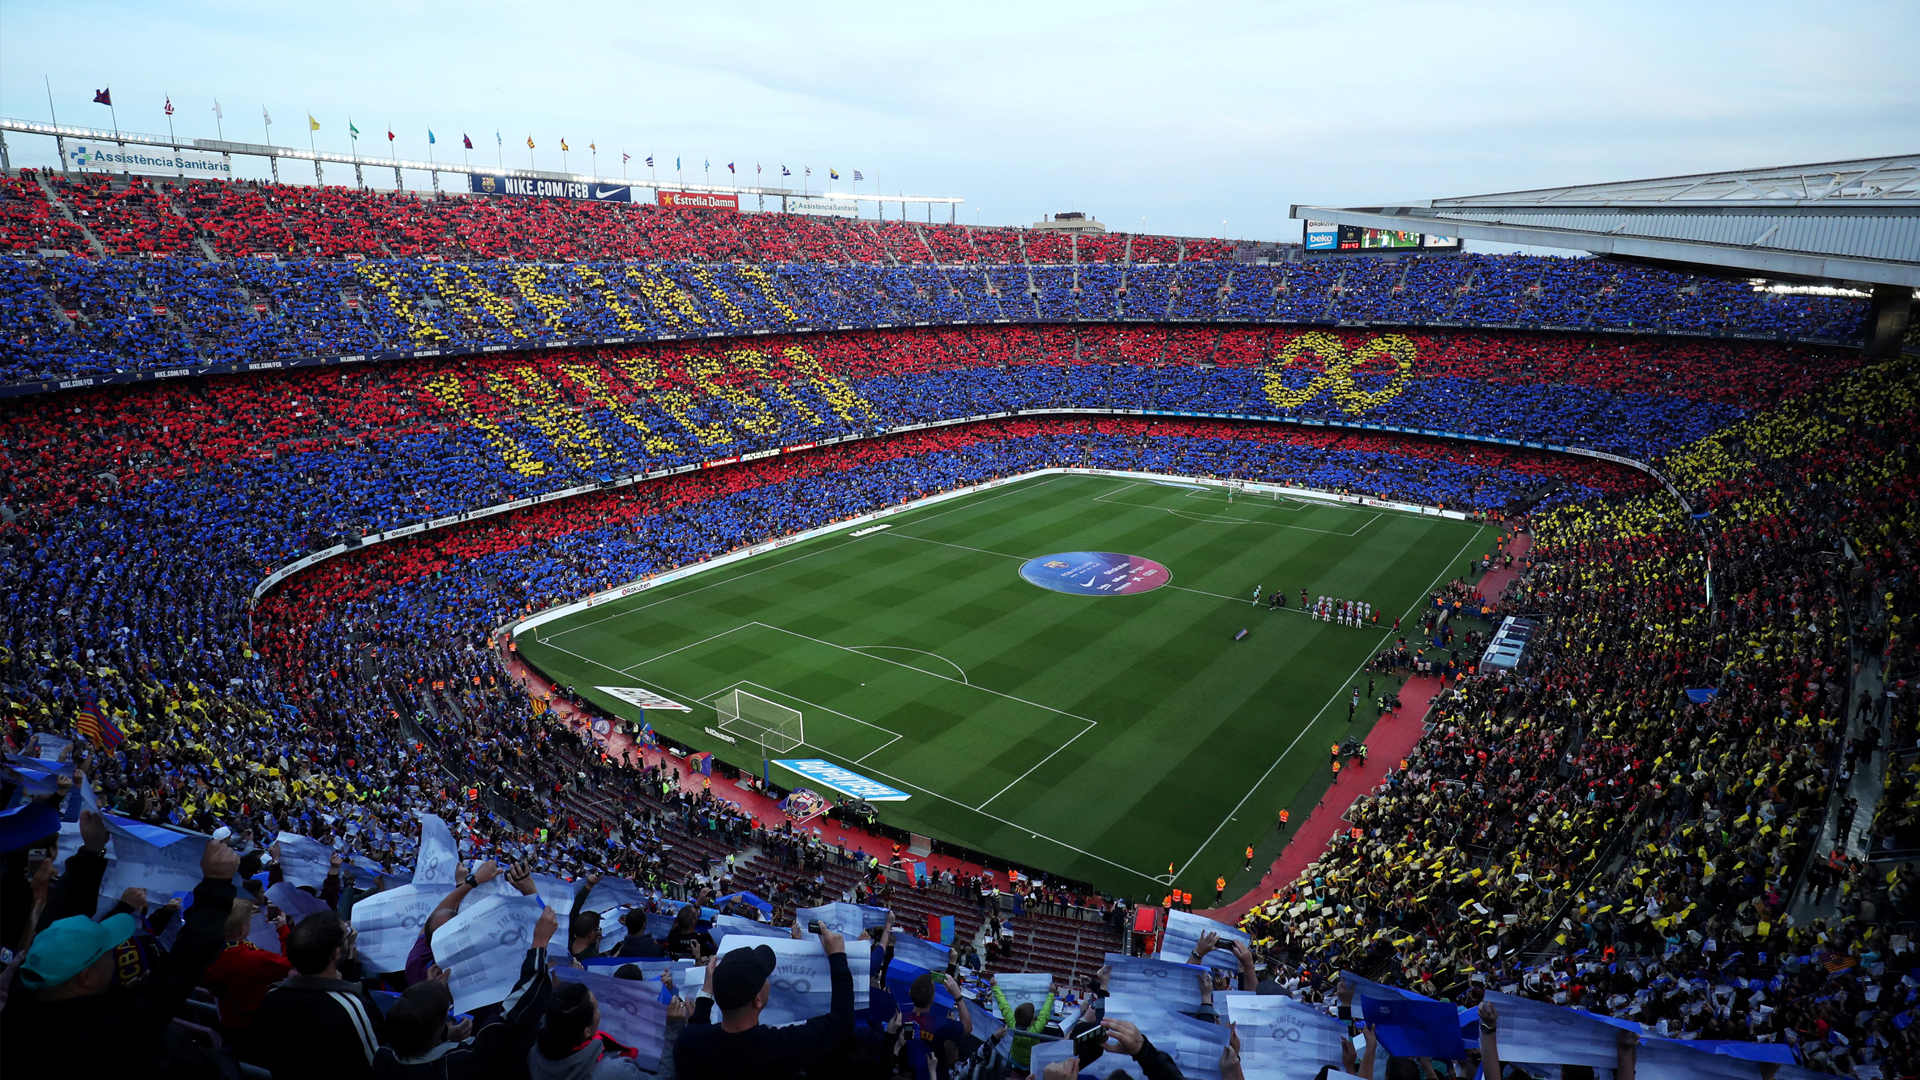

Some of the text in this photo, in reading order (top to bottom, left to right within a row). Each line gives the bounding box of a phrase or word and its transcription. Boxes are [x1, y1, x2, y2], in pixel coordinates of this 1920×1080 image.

[94, 150, 230, 172] Assistència Sanitària
[504, 178, 589, 199] NIKE.COM/FCB
[673, 193, 736, 208] Estrella Damm
[1310, 234, 1333, 243] beko
[248, 361, 282, 370] NIKE.COM/FCB
[154, 368, 190, 378] NIKE.COM/FCB
[59, 378, 94, 389] NIKE.COM/FCB
[1566, 447, 1590, 455] KONAMI
[1595, 452, 1617, 460] KONAMI
[512, 499, 530, 508] Rakuten
[1373, 500, 1396, 509] Rakuten
[477, 508, 495, 517] Rakuten
[437, 517, 457, 526] Rakuten
[396, 527, 417, 536] Rakuten
[778, 537, 797, 546] Rakuten
[627, 582, 651, 593] Rakuten
[405, 901, 431, 914] INIESTA
[777, 965, 817, 979] INIESTA
[1276, 1015, 1306, 1029] INIESTA
